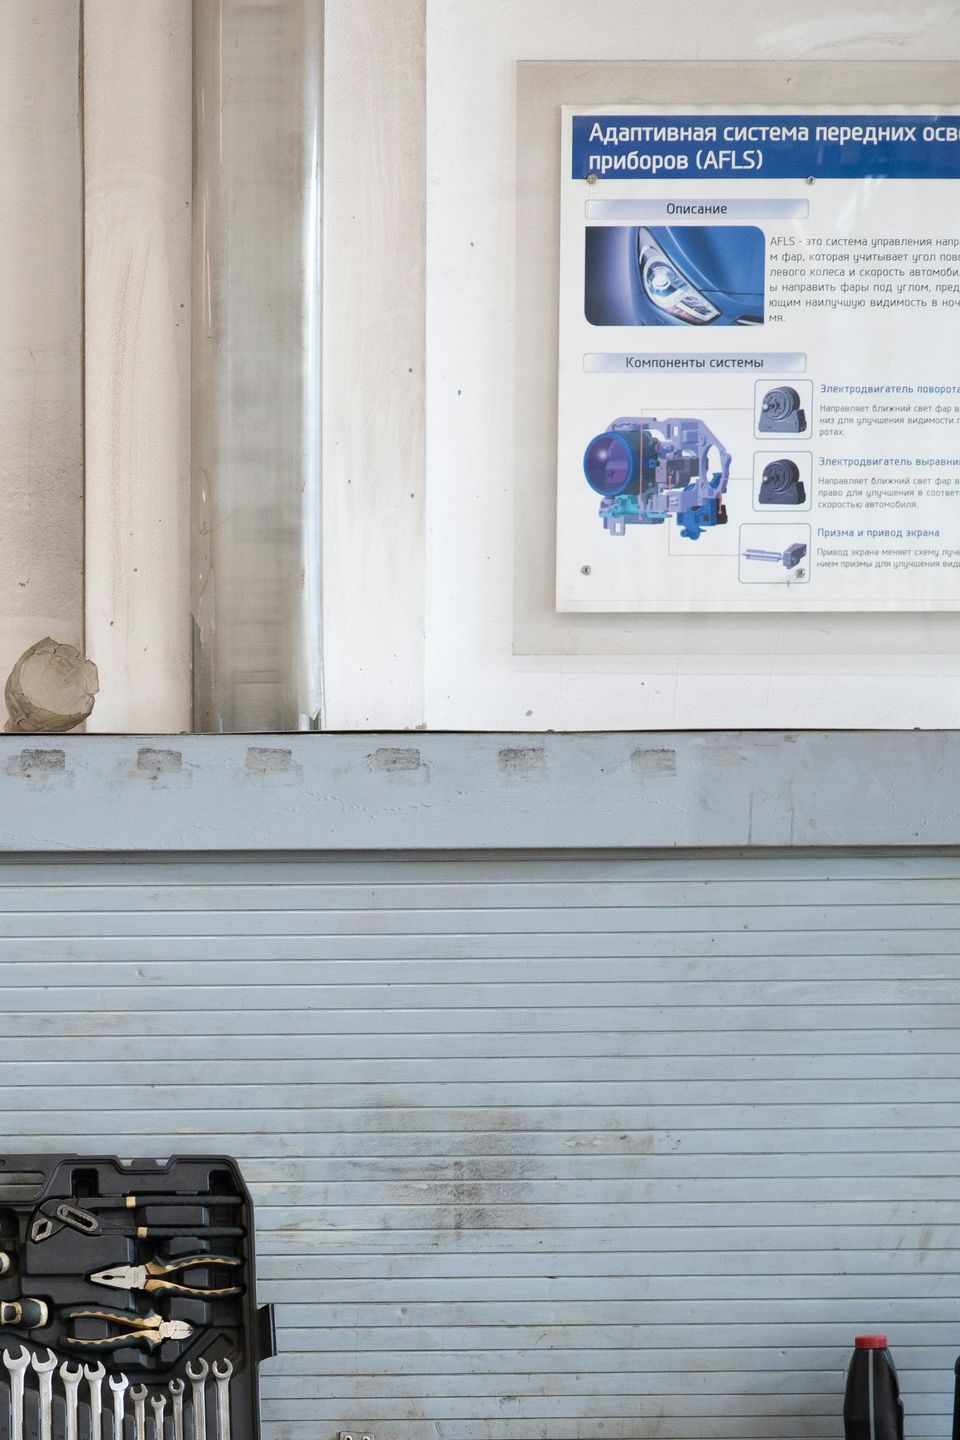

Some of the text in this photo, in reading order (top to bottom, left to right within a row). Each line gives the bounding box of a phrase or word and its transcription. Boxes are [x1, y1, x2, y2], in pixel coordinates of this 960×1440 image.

[589, 123, 960, 146] Адаптивная система передних осв
[590, 151, 763, 174] приборов (AFLS)
[666, 203, 728, 215] Описание
[770, 237, 795, 246] AFLS
[806, 238, 822, 246] это
[826, 238, 867, 246] система
[871, 238, 932, 248] управления
[782, 251, 805, 262] фар,
[809, 254, 849, 263] которая
[853, 253, 908, 263] учитывает
[912, 253, 936, 263] угол
[770, 266, 960, 278] левого колеса и скорость автомоби
[782, 284, 836, 293] направить
[840, 282, 869, 293] фары
[873, 284, 892, 293] под
[897, 284, 931, 293] углом,
[769, 300, 801, 308] ющим
[806, 299, 865, 309] наилучшую
[870, 299, 927, 308] видимость
[626, 357, 764, 368] Компоненты системы
[820, 384, 913, 394] Электродвигатель
[820, 405, 869, 413] Направляет
[872, 404, 911, 412] ближний
[857, 417, 904, 426] улучшения
[908, 417, 954, 425] видимости
[819, 457, 960, 467] Электродвигатель выравни
[866, 490, 914, 498] улучшения
[817, 528, 854, 538] Призма
[867, 529, 903, 538] привод
[906, 530, 940, 538] экрана
